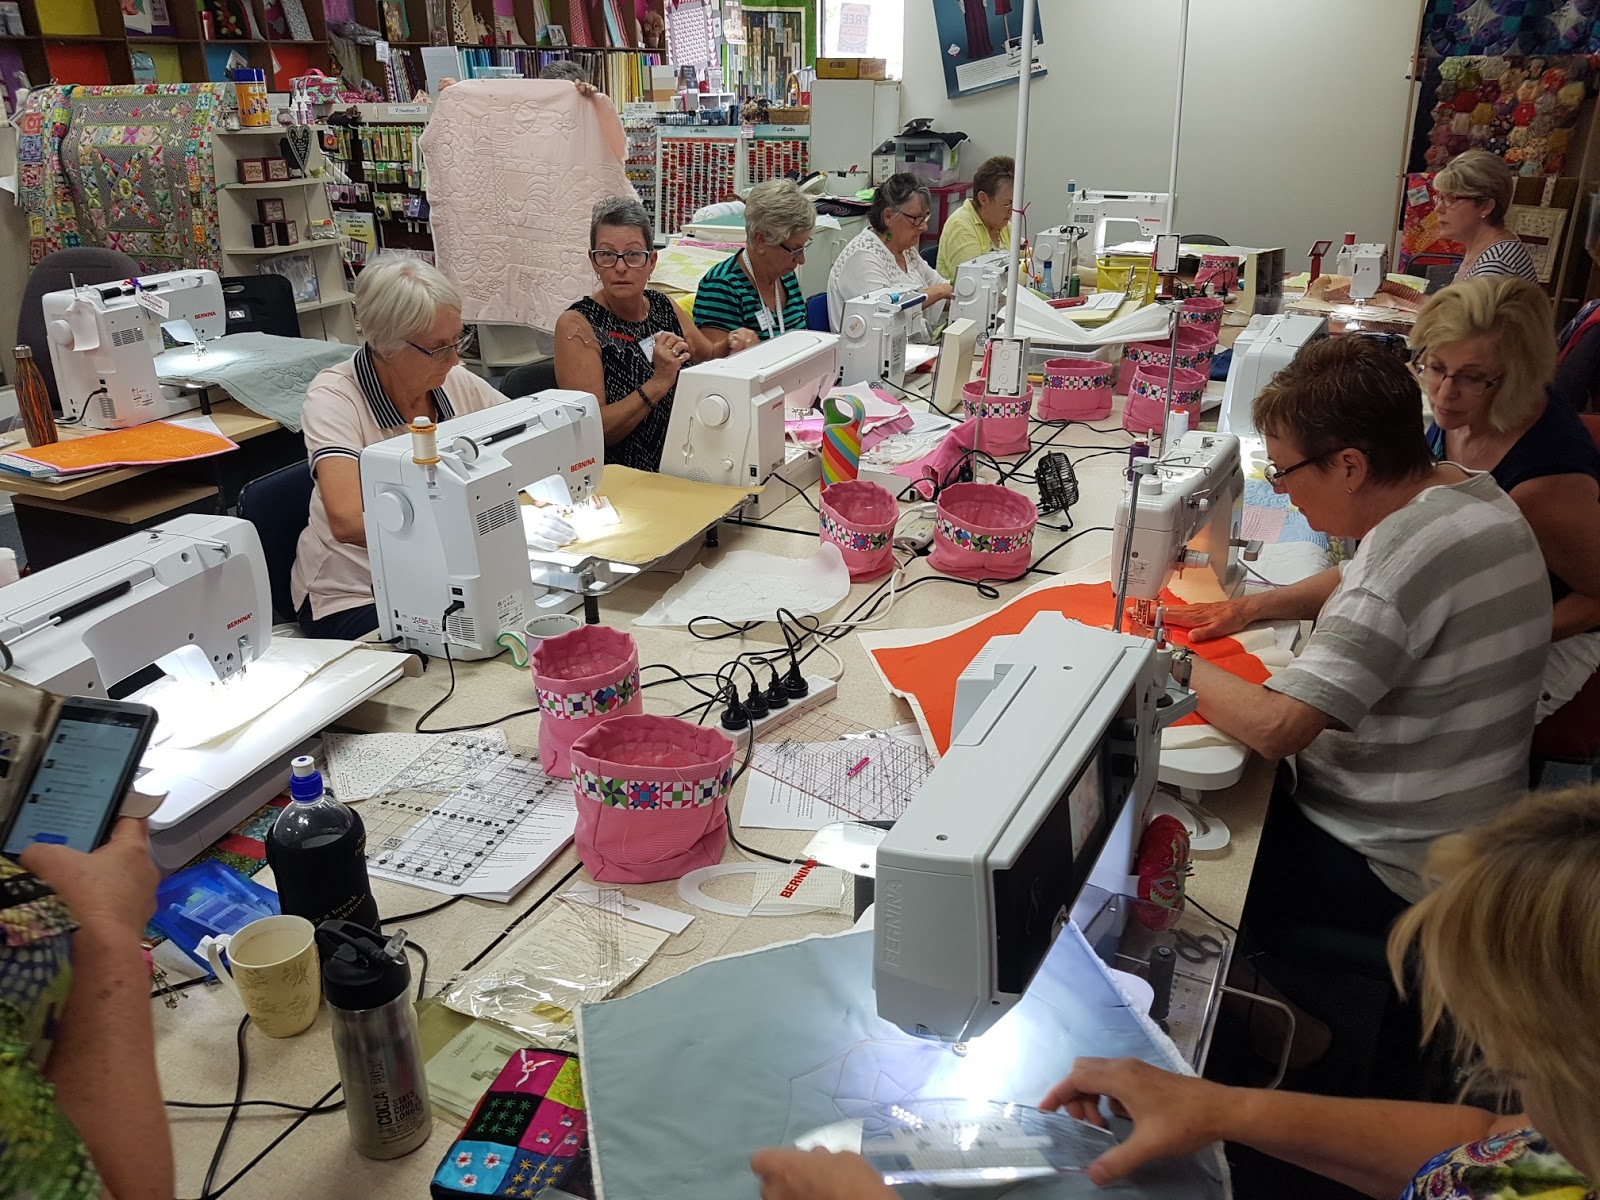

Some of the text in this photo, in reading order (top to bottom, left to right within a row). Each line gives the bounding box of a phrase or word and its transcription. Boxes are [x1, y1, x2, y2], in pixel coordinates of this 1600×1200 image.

[194, 311, 217, 320] BERNINA
[570, 457, 596, 473] BERNINA
[226, 613, 251, 630] BERNINA
[331, 894, 359, 916] break
[884, 879, 903, 967] BERNINA
[392, 1088, 415, 1108] STAYS
